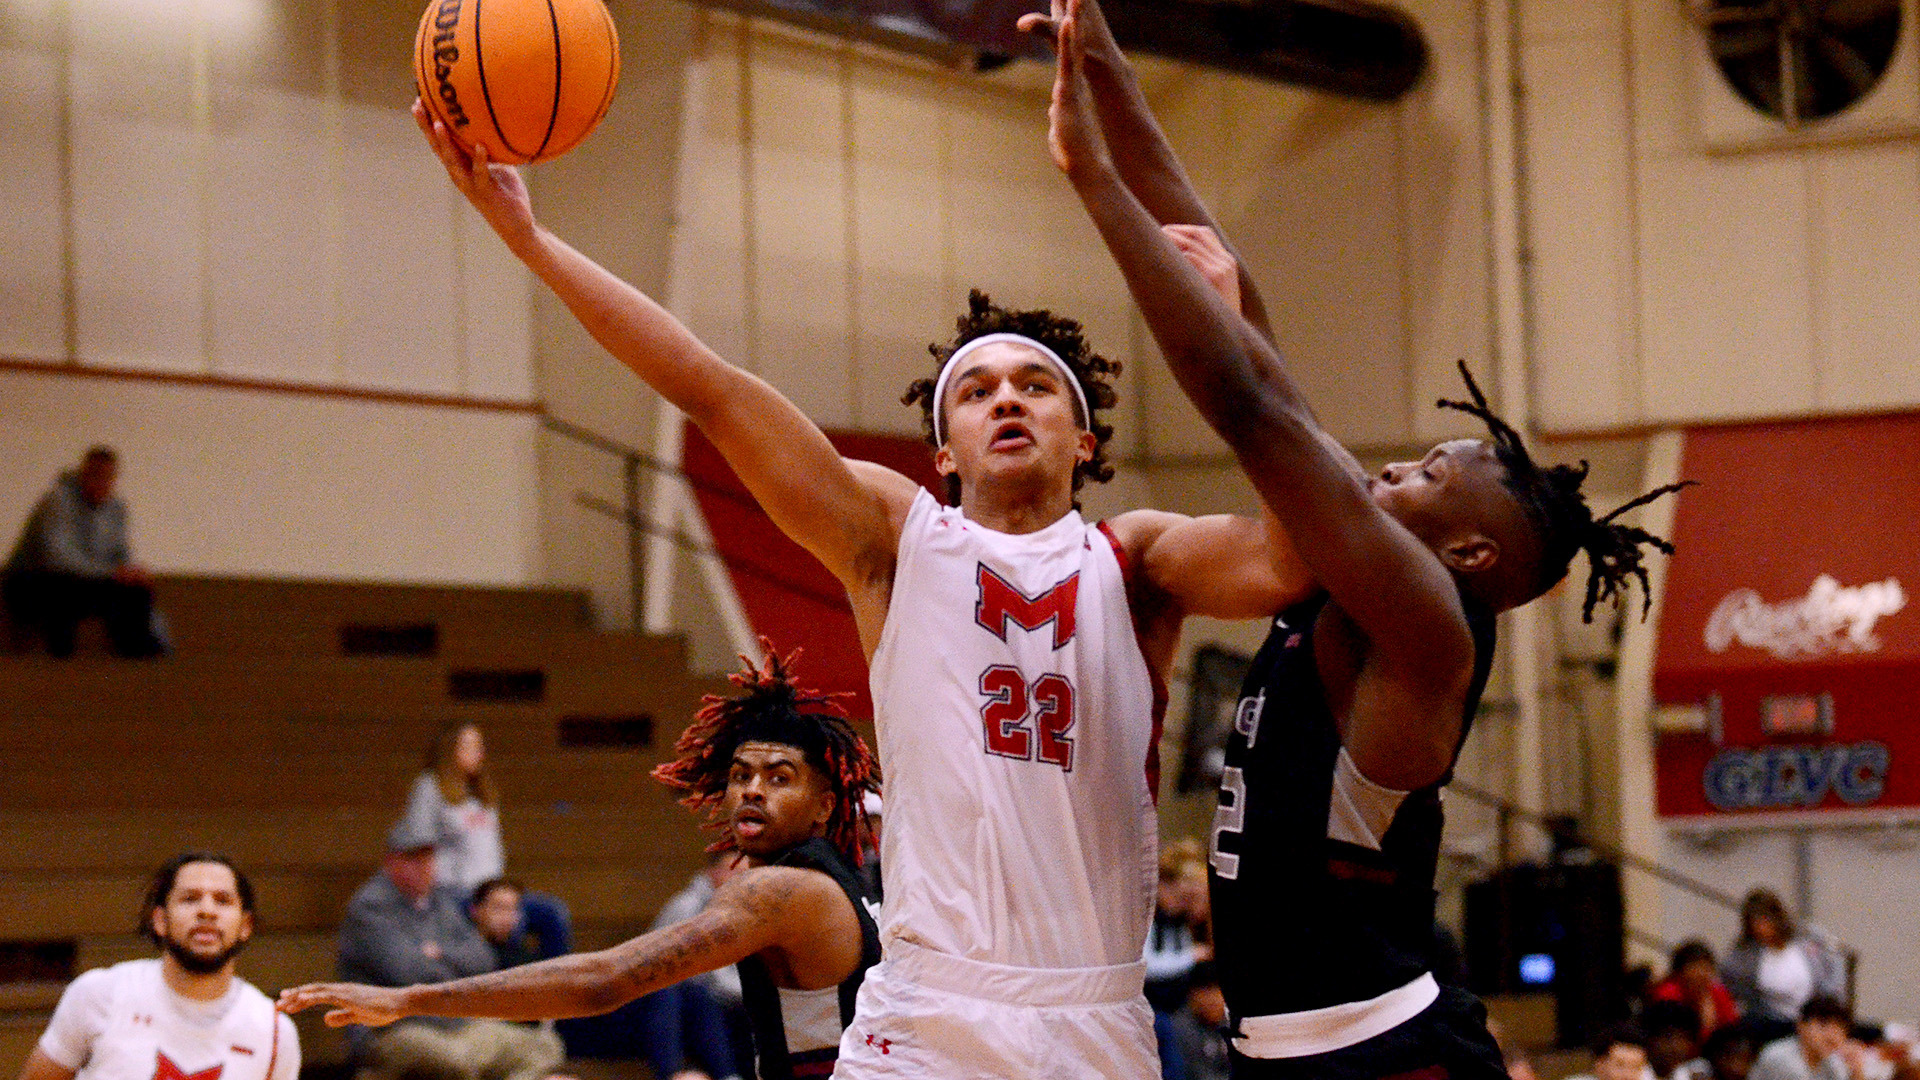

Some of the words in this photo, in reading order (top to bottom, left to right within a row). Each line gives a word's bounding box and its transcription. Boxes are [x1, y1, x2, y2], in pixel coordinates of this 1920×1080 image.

[433, 0, 470, 127] Wilson
[975, 560, 1080, 650] M
[978, 664, 1076, 773] 22
